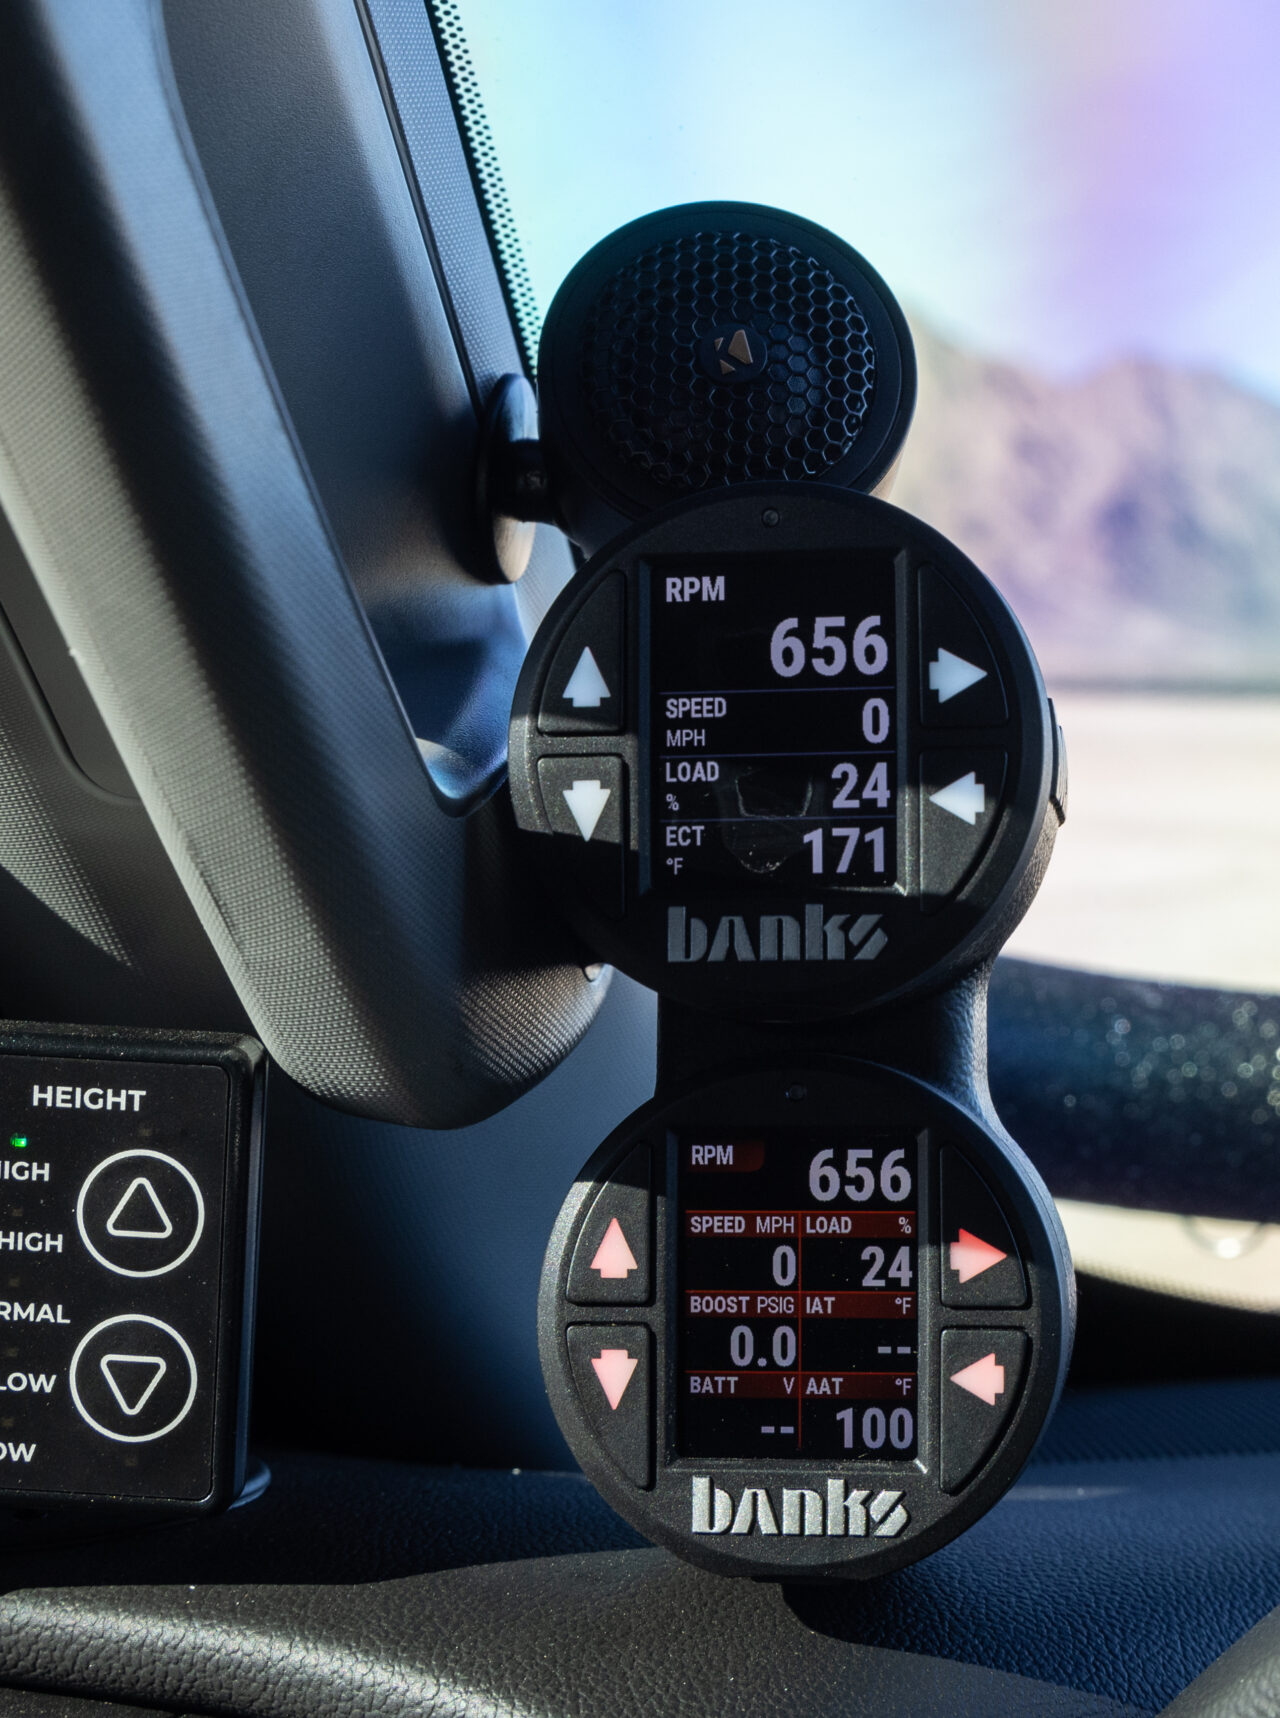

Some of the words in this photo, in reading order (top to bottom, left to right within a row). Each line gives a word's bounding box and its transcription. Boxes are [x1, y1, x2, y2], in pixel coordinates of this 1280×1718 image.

[665, 575, 725, 602] RPM
[770, 615, 888, 677] 656
[665, 696, 727, 718] SPEED
[862, 697, 889, 744] 0
[666, 729, 706, 747] MPH
[665, 760, 720, 782] LOAD
[831, 761, 890, 808] 24
[666, 793, 679, 811] %
[665, 825, 705, 847] ECT
[803, 826, 885, 874] 171
[667, 903, 888, 962] banks
[32, 1084, 146, 1112] HEIGHT
[691, 1144, 733, 1165] RPM
[809, 1148, 912, 1202] 656
[690, 1215, 746, 1234] SPEED
[756, 1215, 795, 1234] MPH
[806, 1216, 852, 1234] LOAD
[898, 1216, 911, 1234] %
[772, 1244, 797, 1287] 0
[860, 1245, 913, 1287] 24
[690, 1295, 750, 1314] BOOST
[757, 1296, 795, 1314] PSIG
[806, 1296, 836, 1314] IAT
[730, 1325, 797, 1368] 0.0
[690, 1375, 739, 1394] BATT
[783, 1376, 795, 1394] V
[805, 1377, 844, 1395] AAT
[835, 1407, 914, 1450] 100
[691, 1475, 909, 1537] banks
